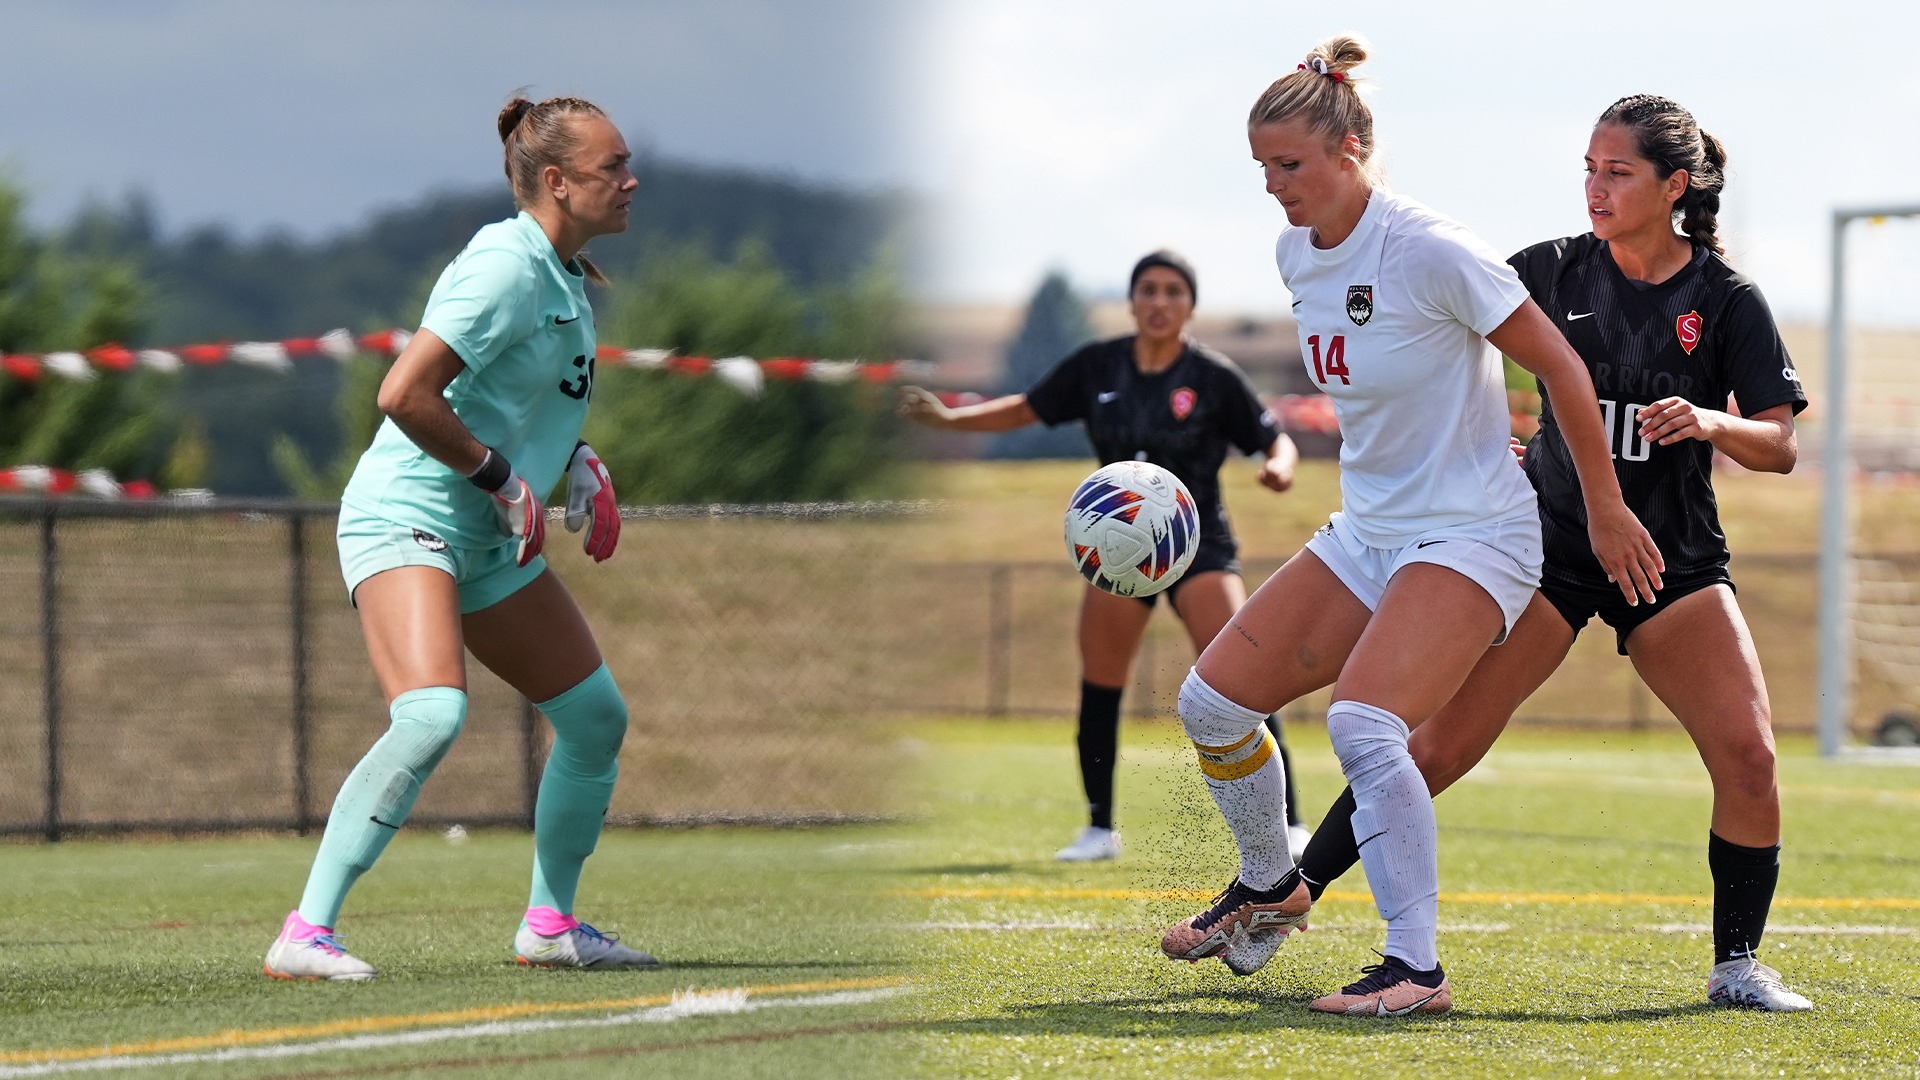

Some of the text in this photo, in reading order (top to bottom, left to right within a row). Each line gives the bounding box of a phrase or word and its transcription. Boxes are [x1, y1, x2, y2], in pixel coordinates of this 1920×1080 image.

[1682, 317, 1697, 343] S
[559, 354, 596, 404] 3
[1308, 335, 1350, 385] 14
[1596, 362, 1706, 402] RRIORS
[1599, 398, 1651, 461] 10
